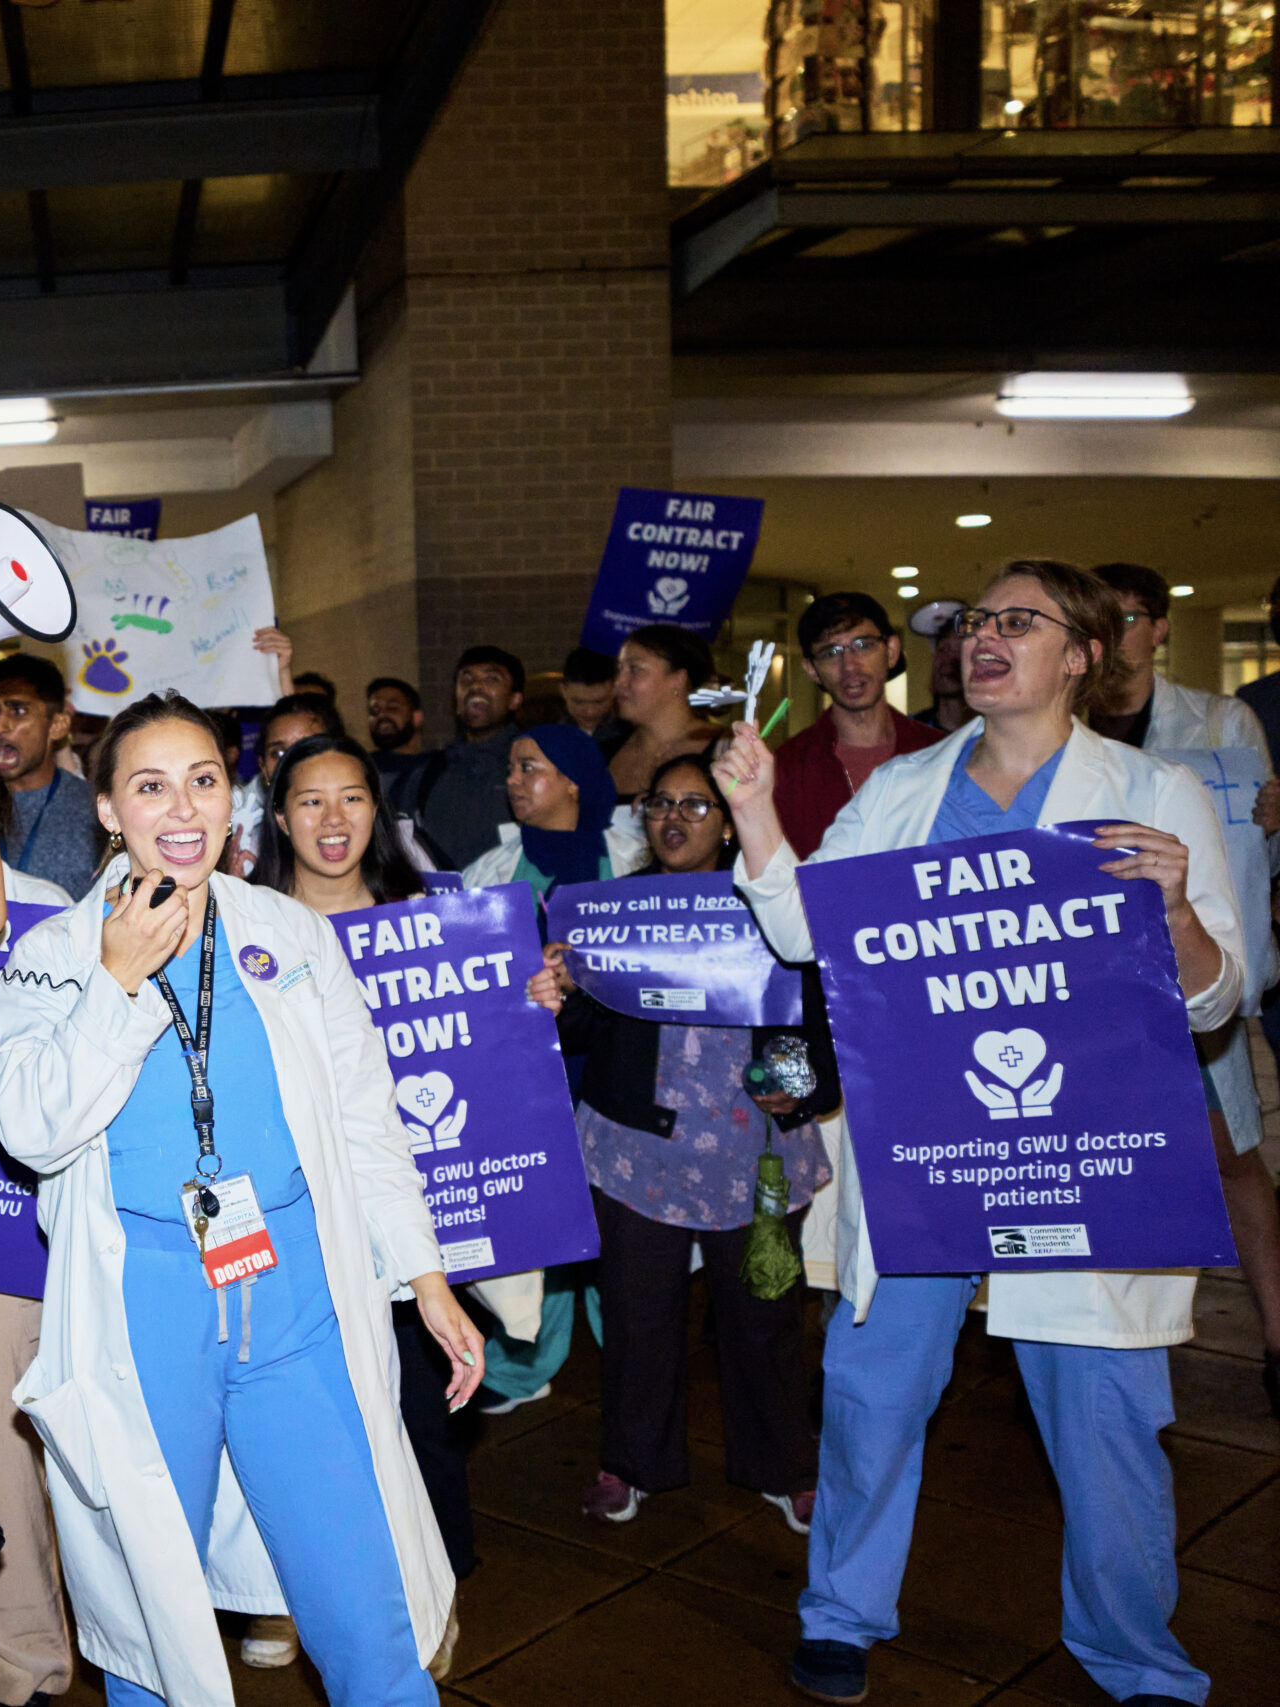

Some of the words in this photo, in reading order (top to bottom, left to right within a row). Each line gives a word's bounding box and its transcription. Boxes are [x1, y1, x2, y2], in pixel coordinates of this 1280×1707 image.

[90, 507, 131, 524] FAIR
[665, 498, 716, 521] FAIR
[627, 522, 744, 551] CONTRACT
[647, 550, 710, 574] NOW!
[913, 848, 1035, 901] FAIR
[577, 902, 622, 915] They
[628, 896, 661, 911] call
[667, 898, 688, 909] us
[694, 894, 748, 911] hero
[347, 913, 445, 960] FAIR
[568, 926, 630, 945] GWU
[636, 923, 736, 943] TREATS
[744, 923, 761, 942] U
[853, 893, 1126, 965] CONTRACT
[586, 953, 642, 972] LIKE
[355, 951, 514, 1010] NTRACT
[925, 961, 1071, 1015] NOW!
[202, 991, 210, 1006] LIVES
[201, 1008, 209, 1027] MATTER
[892, 1138, 1010, 1165] Supporting
[1017, 1134, 1068, 1155] GWU
[1075, 1131, 1167, 1151] doctors
[433, 1161, 474, 1183] GWU
[480, 1151, 547, 1175] doctors
[928, 1165, 946, 1184] is
[952, 1160, 1071, 1186] supporting
[1080, 1157, 1133, 1177] GWU
[424, 1185, 478, 1207] orting
[483, 1175, 523, 1197] GWU
[983, 1186, 1081, 1211] patients!
[432, 1204, 486, 1229] tients!
[213, 1249, 274, 1285] DOCTOR
